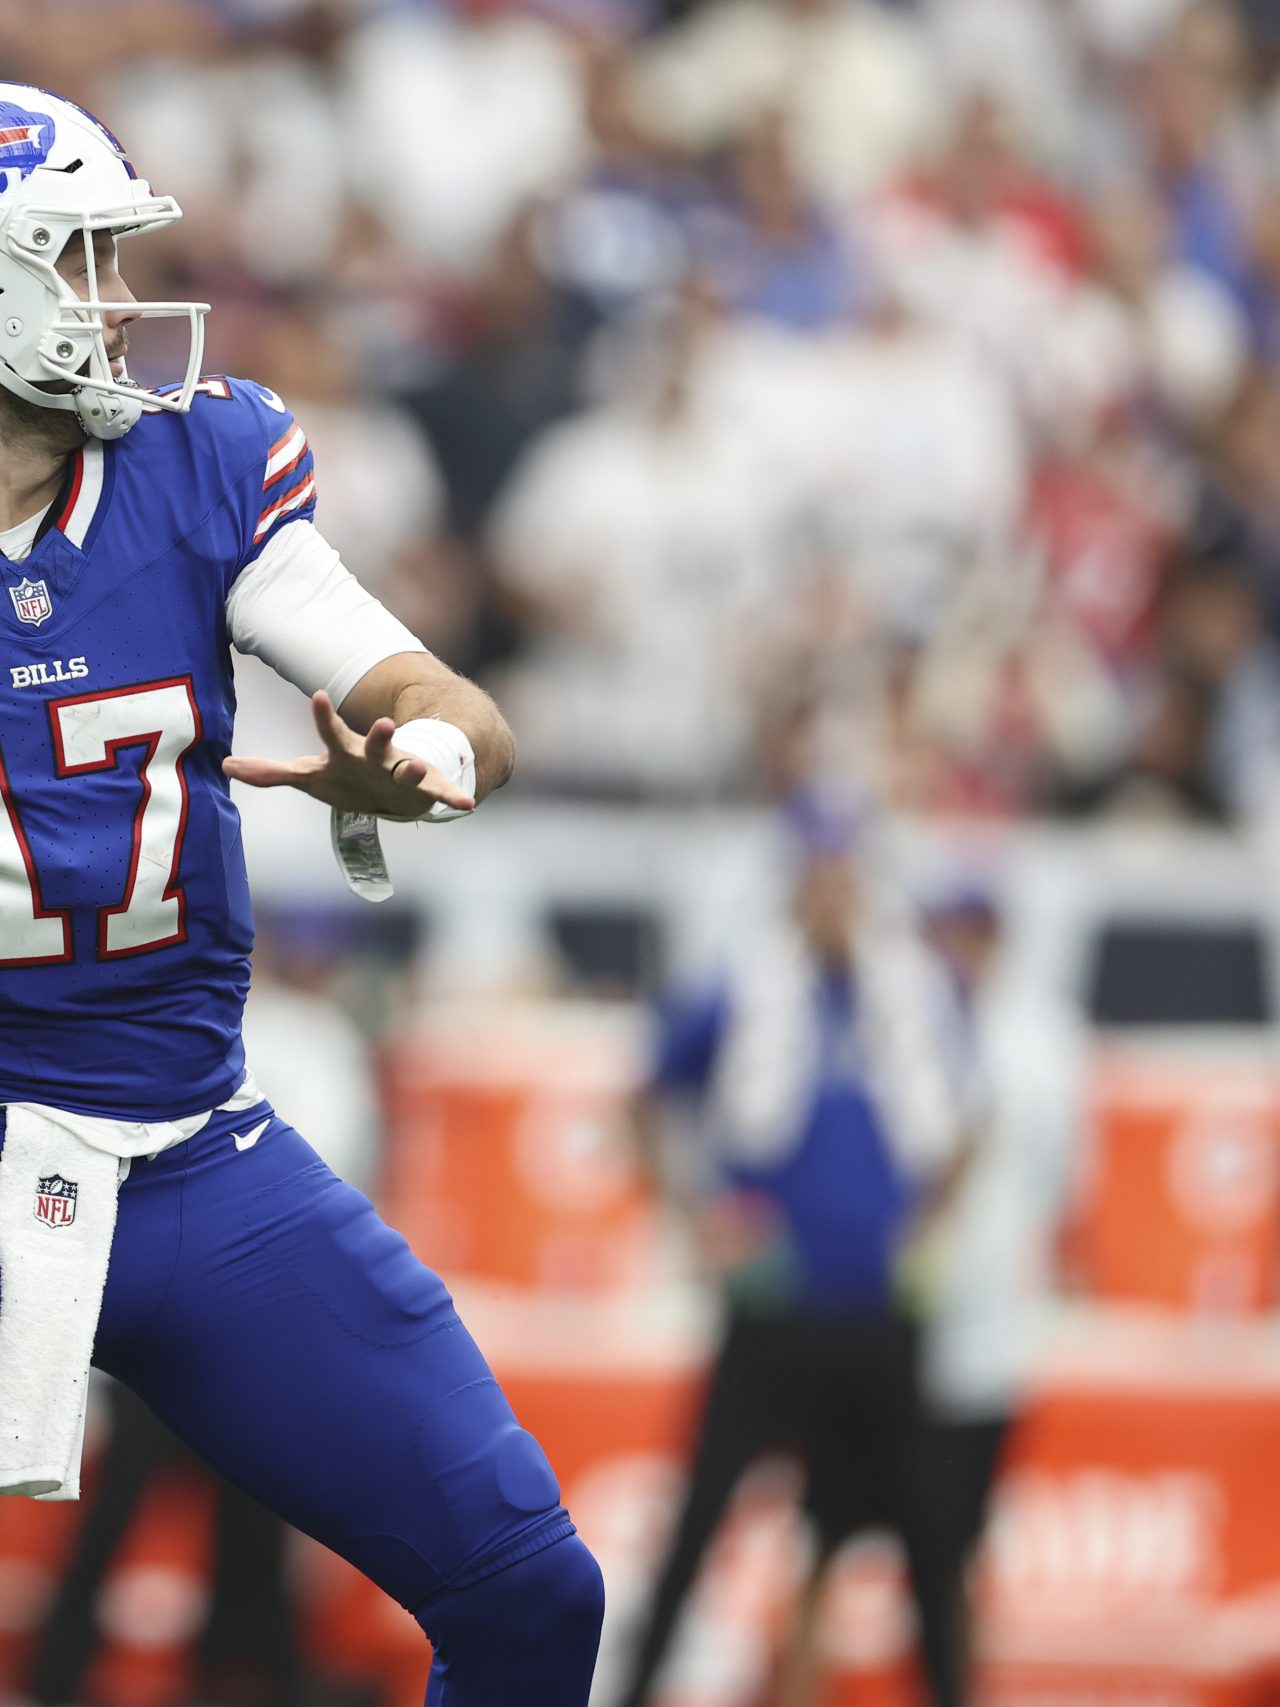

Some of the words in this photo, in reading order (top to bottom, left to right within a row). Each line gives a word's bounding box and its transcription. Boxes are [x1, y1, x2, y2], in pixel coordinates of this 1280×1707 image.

[19, 598, 47, 618] NFL
[9, 656, 89, 688] BILLS
[35, 1195, 72, 1223] NFL
